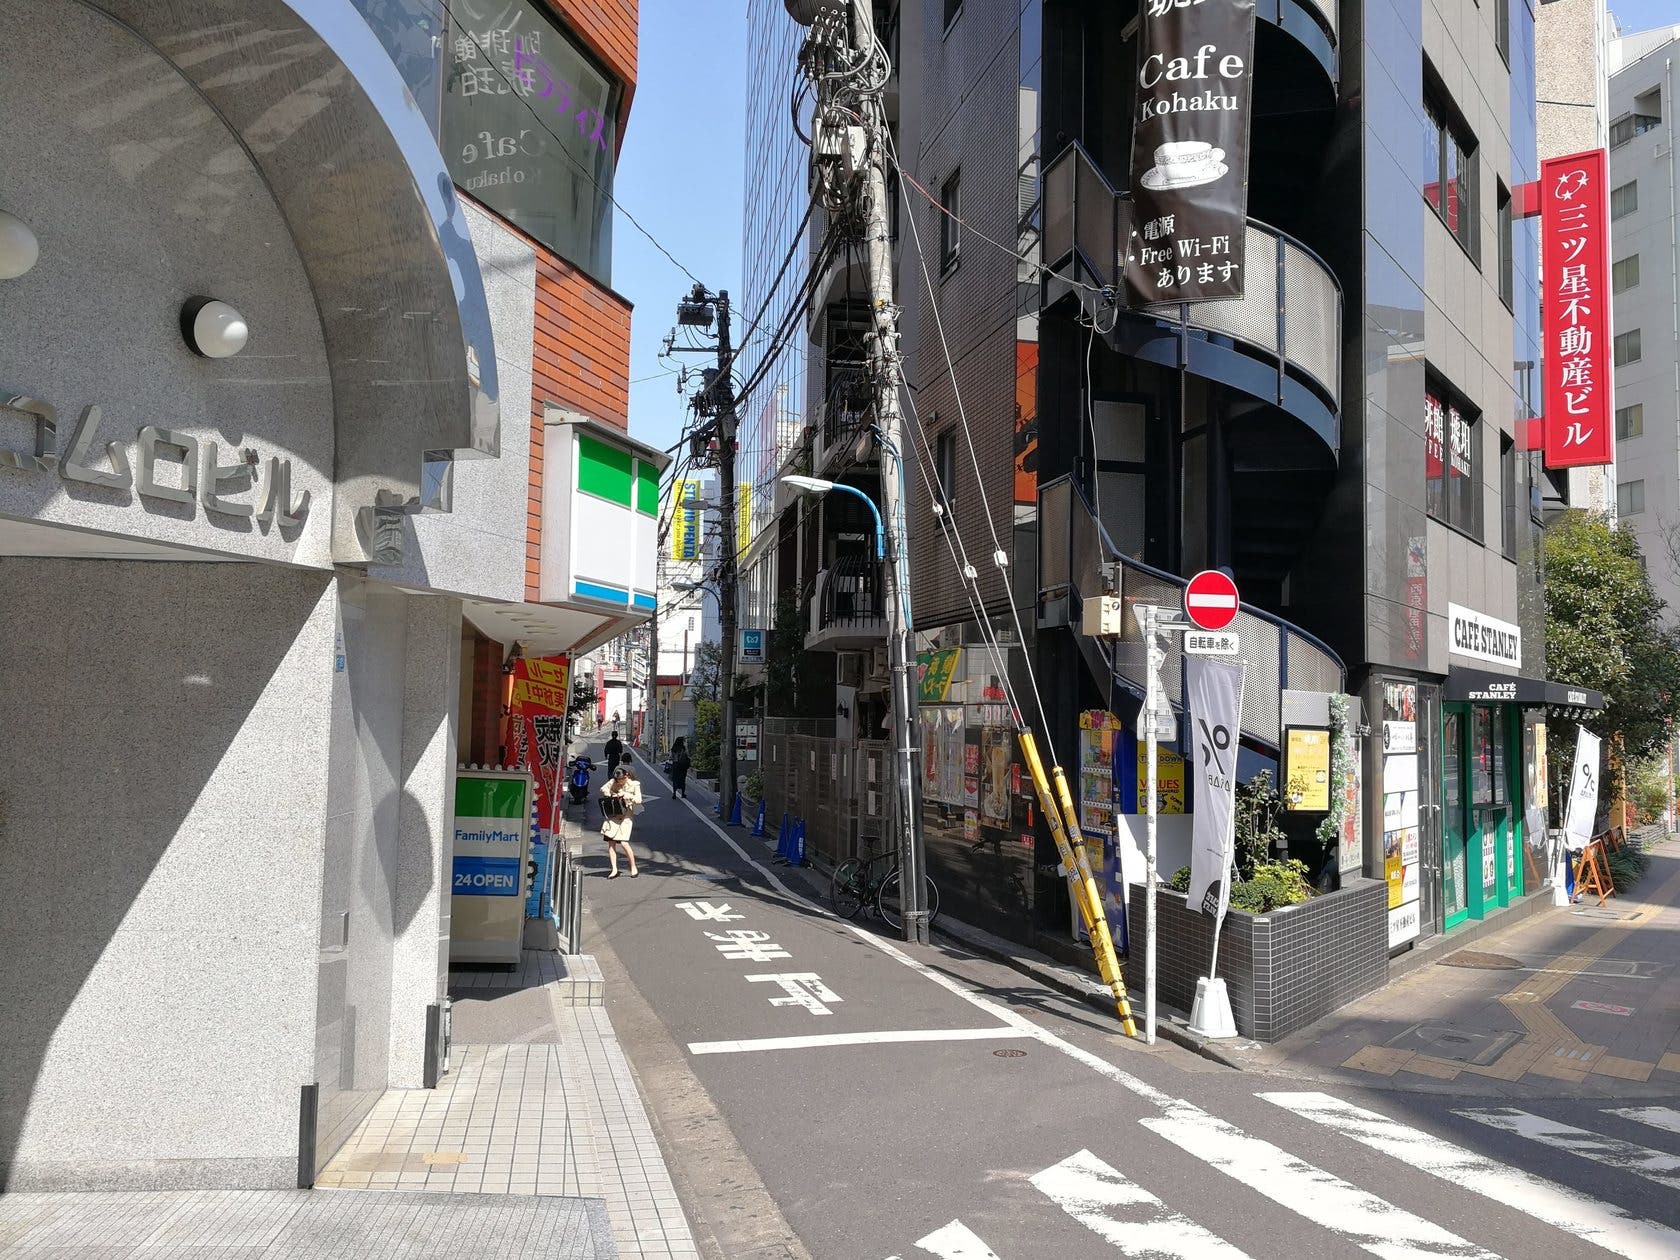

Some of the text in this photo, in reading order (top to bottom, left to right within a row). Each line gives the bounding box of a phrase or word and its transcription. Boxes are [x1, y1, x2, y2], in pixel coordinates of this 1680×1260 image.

[1139, 44, 1244, 89] Cafe
[1141, 91, 1238, 123] Kohaku
[1144, 213, 1175, 241] 電源
[1140, 236, 1230, 266] Free Wi-Fi
[1157, 260, 1240, 288] あります
[1558, 202, 1596, 449] 三ツ星不動産ビル
[684, 525, 696, 558] PENTA
[1189, 636, 1235, 651] 自転車を除く
[1454, 615, 1479, 652] CAFÉ
[1481, 625, 1518, 660] STANLEY
[1468, 691, 1517, 700] STANLEY
[1488, 681, 1517, 691] CAFÉ
[455, 829, 520, 844] FamilyMart
[455, 874, 514, 888] 24 OPEN
[674, 901, 844, 1015] 止まれ
